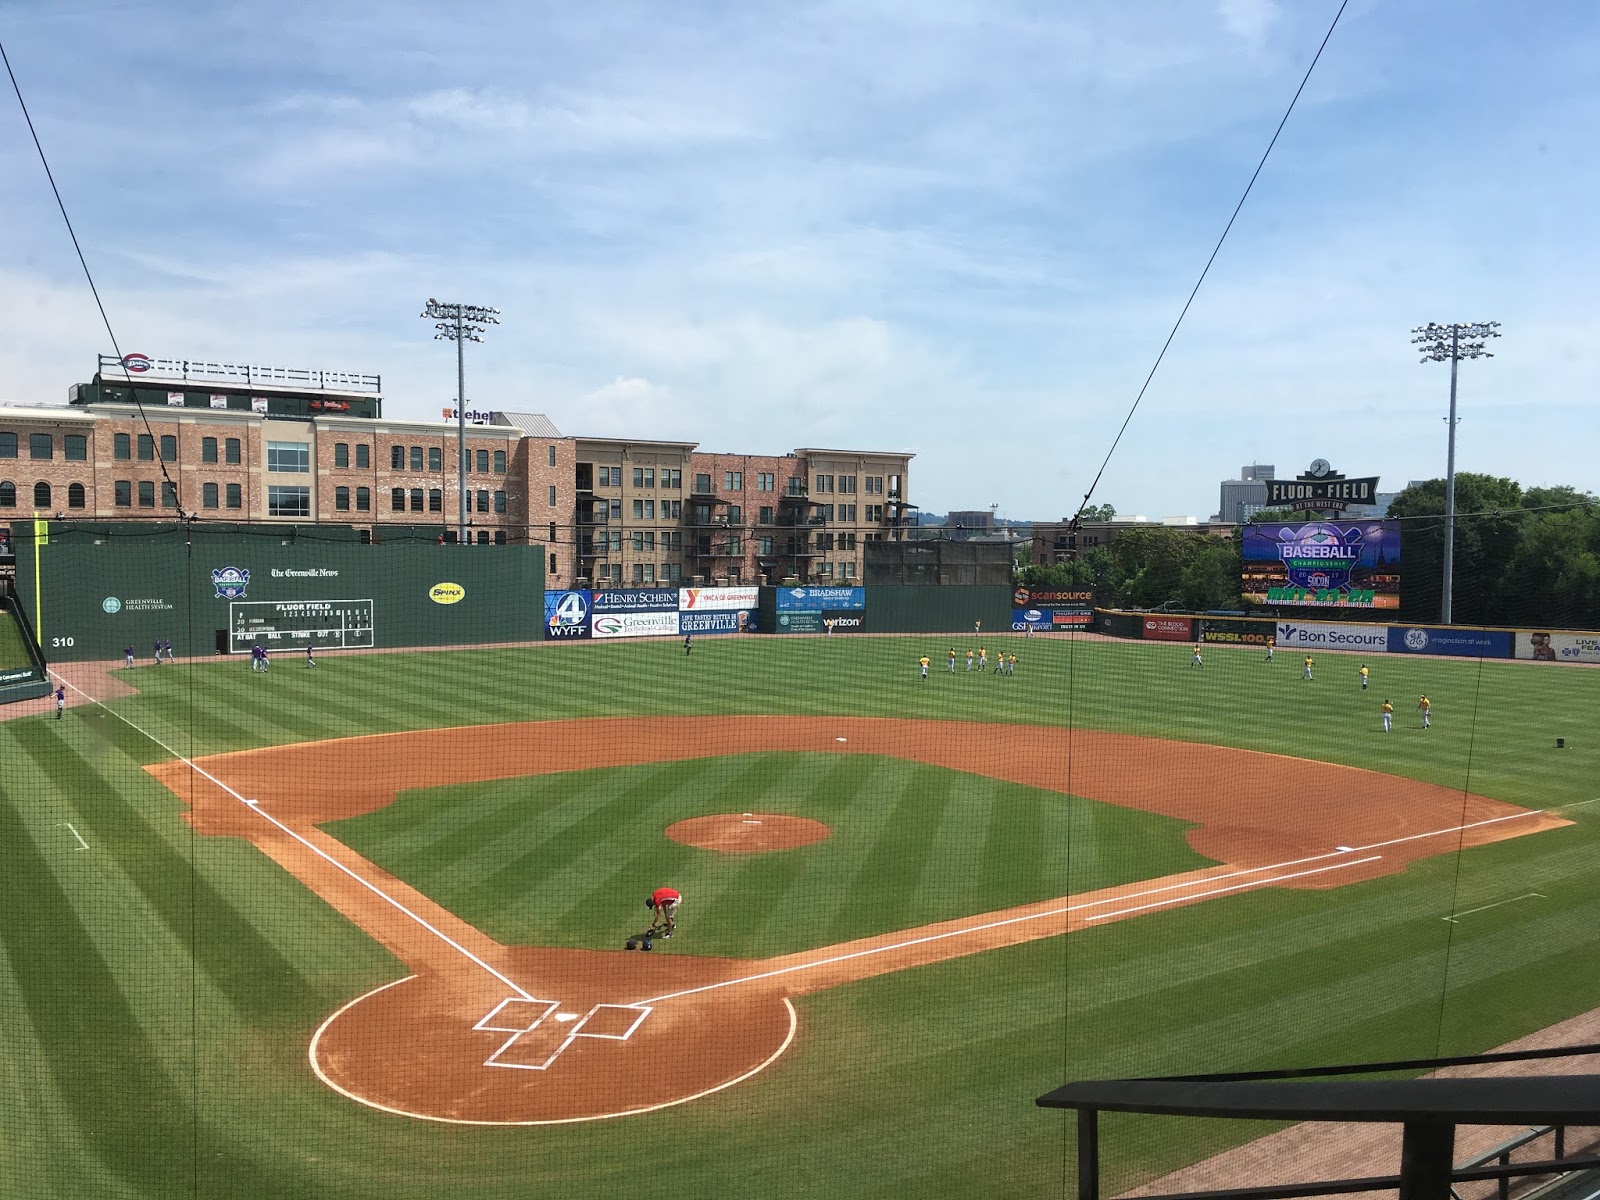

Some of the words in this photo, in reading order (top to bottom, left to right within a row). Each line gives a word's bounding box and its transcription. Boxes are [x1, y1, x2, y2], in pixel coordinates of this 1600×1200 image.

[1273, 484, 1312, 500] FLUOR
[1328, 482, 1368, 498] FIELD
[1284, 546, 1356, 558] BASEBALL
[271, 569, 284, 577] The
[285, 569, 318, 577] Greenville
[604, 593, 638, 603] HENRY
[1032, 592, 1092, 600] scansource
[1267, 588, 1307, 600] MAY
[558, 594, 584, 622] 4
[624, 616, 676, 626] Greenville
[682, 620, 736, 631] GREENVILLE
[550, 626, 586, 636] WYFF
[1299, 630, 1326, 642] Bon
[1328, 631, 1386, 645] Secours
[52, 638, 74, 648] 310
